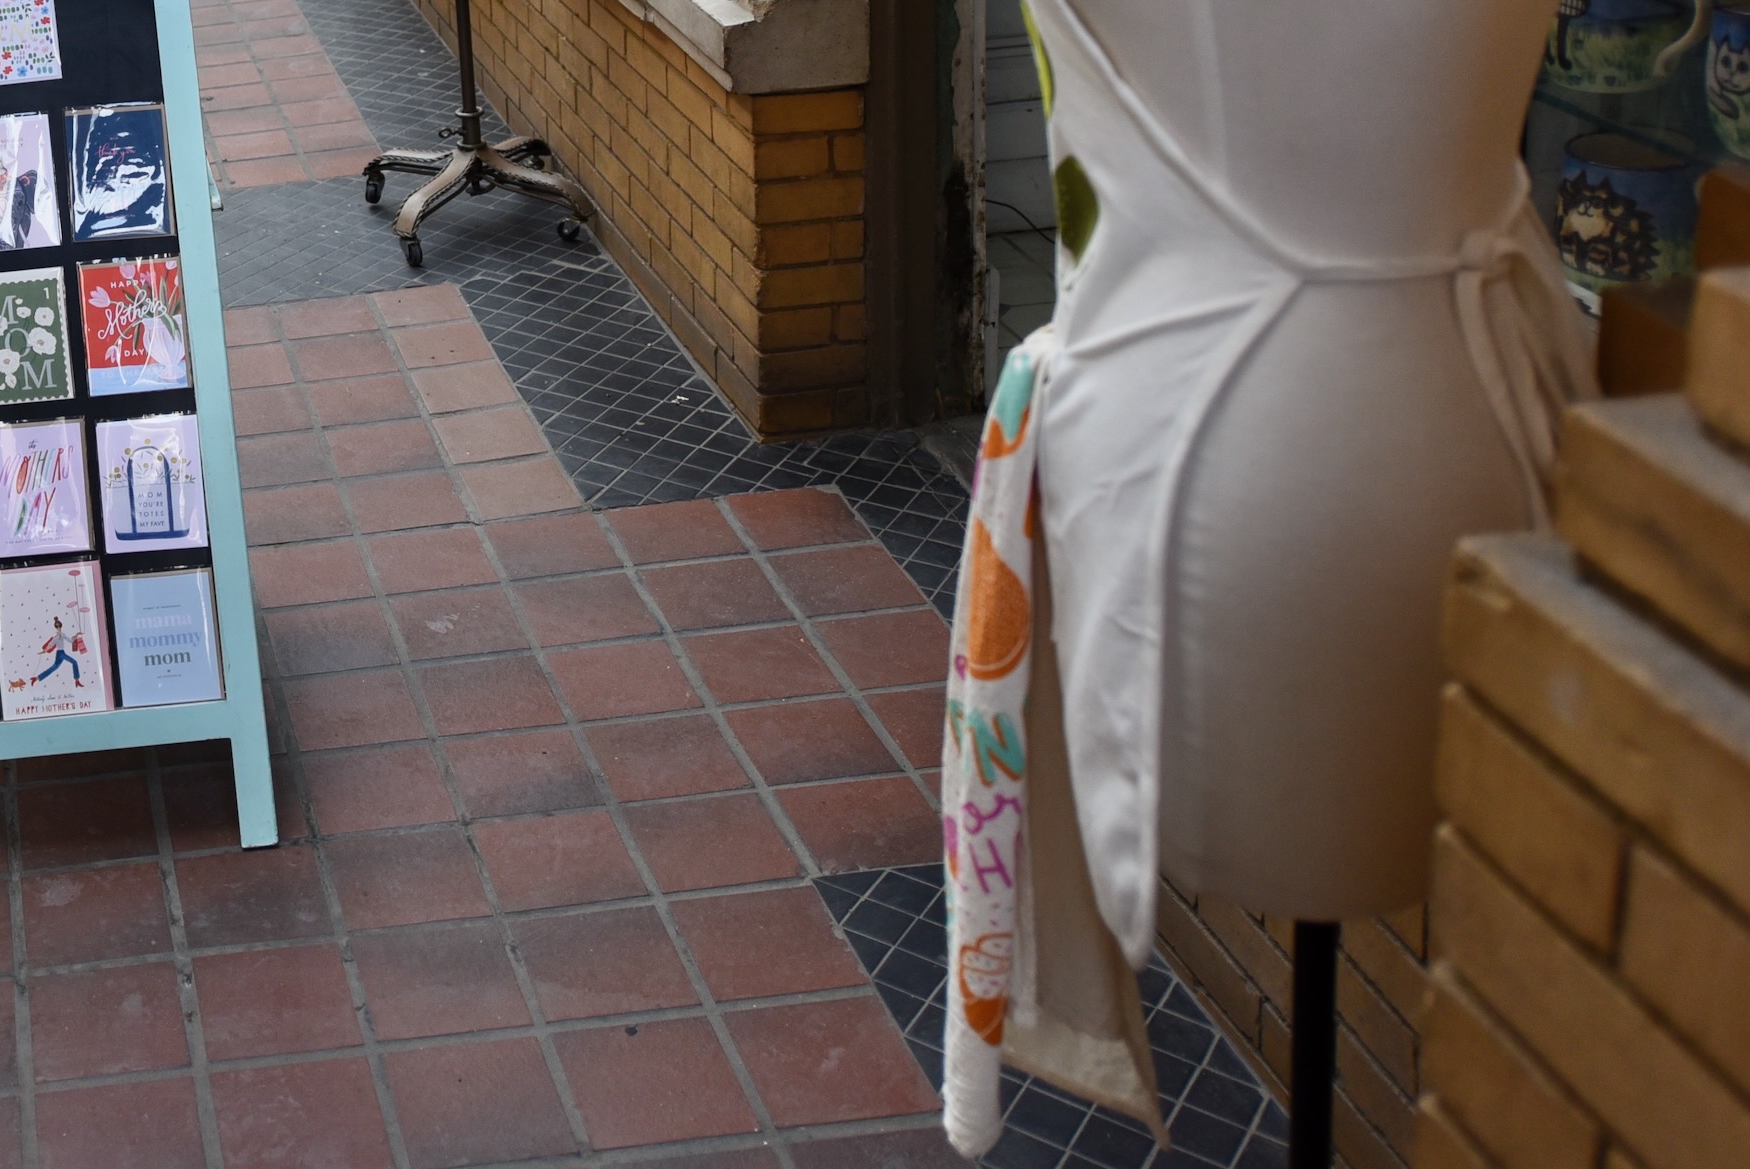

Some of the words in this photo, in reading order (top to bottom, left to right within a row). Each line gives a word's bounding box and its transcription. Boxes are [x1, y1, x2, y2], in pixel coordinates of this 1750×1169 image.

[110, 279, 146, 289] HAPPY
[43, 287, 49, 300] 1
[135, 614, 192, 629] mama
[129, 632, 202, 649] mommy
[144, 652, 192, 666] mom
[15, 705, 39, 715] HAPPY
[41, 701, 76, 712] MOTHER'S
[79, 700, 92, 709] DAY
